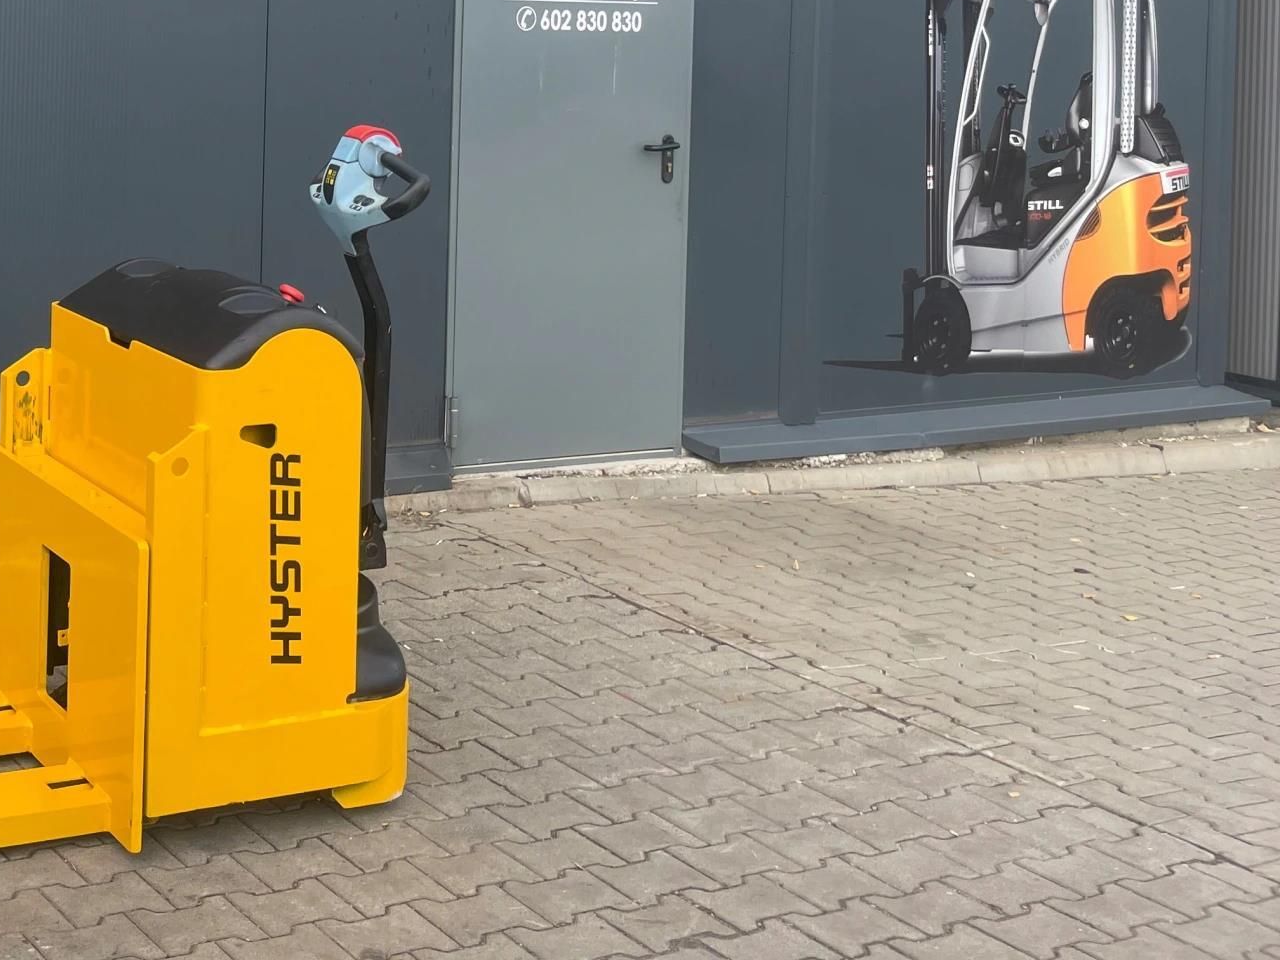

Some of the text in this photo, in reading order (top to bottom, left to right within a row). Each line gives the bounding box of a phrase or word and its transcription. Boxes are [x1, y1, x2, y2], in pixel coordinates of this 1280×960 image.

[540, 9, 642, 32] 602 830 830
[1027, 199, 1064, 211] STILL
[271, 452, 301, 664] HYSTER
